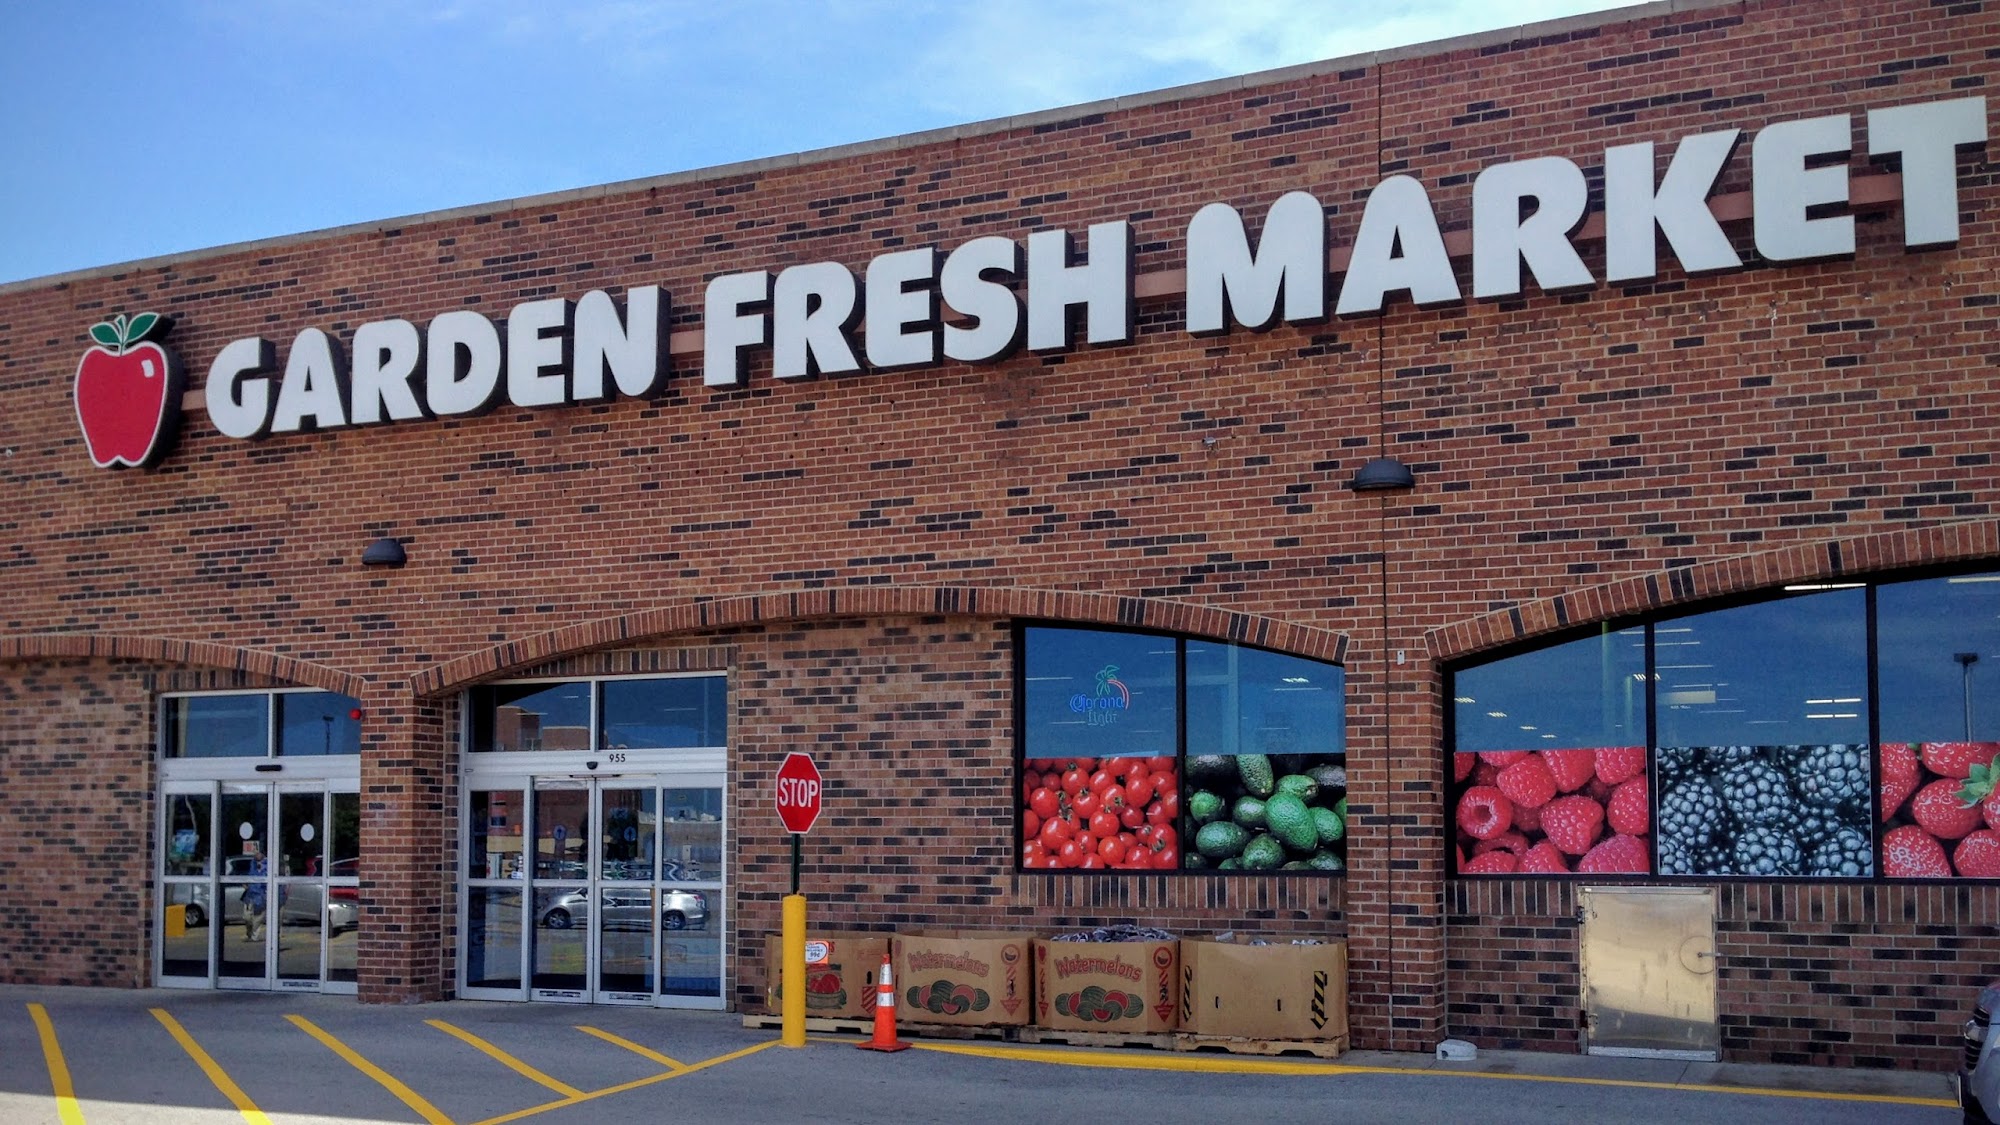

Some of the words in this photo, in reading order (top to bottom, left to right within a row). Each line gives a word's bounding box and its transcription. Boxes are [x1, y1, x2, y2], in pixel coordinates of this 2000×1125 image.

[205, 285, 659, 439] GARDEN
[704, 220, 1128, 387] FRESH
[1186, 96, 1988, 334] MARKET
[1069, 693, 1124, 712] Corona
[1087, 709, 1118, 726] Light
[609, 753, 626, 763] 955
[779, 777, 818, 808] STOP
[907, 949, 990, 978] Watermelons
[1054, 953, 1143, 982] Watermelons
